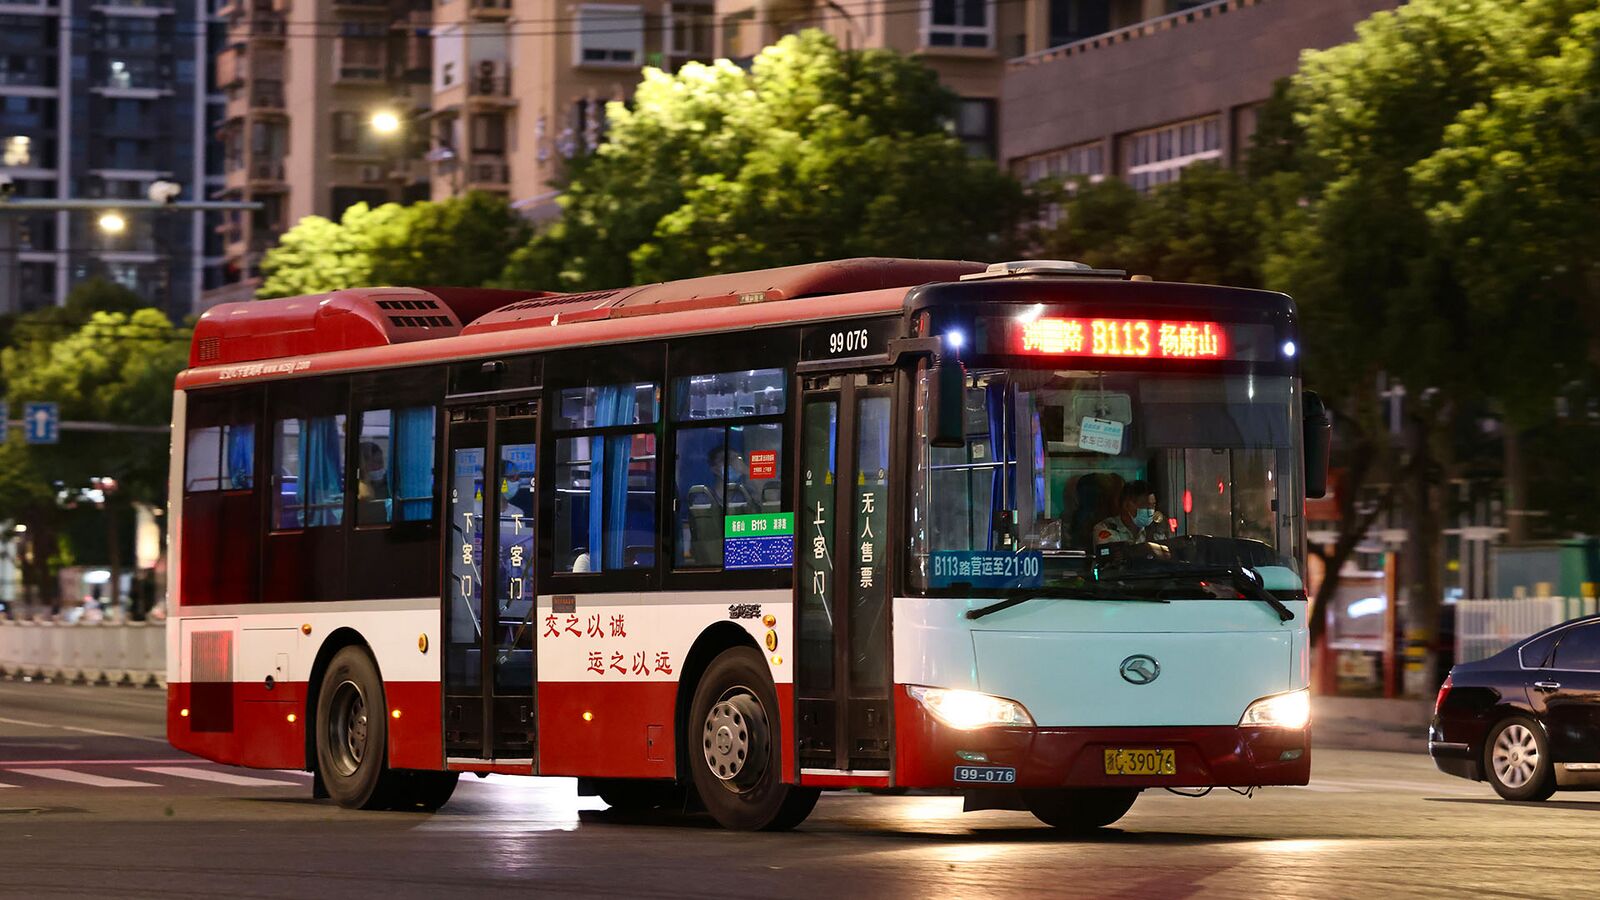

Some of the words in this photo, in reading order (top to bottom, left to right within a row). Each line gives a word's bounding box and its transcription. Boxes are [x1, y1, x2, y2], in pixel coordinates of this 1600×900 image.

[1091, 320, 1150, 356] B113
[1158, 323, 1218, 357] 杨府山
[751, 519, 768, 532] B113
[860, 492, 875, 589] 无人售票
[461, 512, 474, 597] 下客门
[510, 514, 524, 600] 下客门
[813, 500, 826, 595] 上客门
[934, 555, 1040, 577] B113路营运至21:00
[543, 613, 627, 639] 交之以诚
[586, 650, 673, 677] 运之以远
[960, 768, 1014, 781] 99-076
